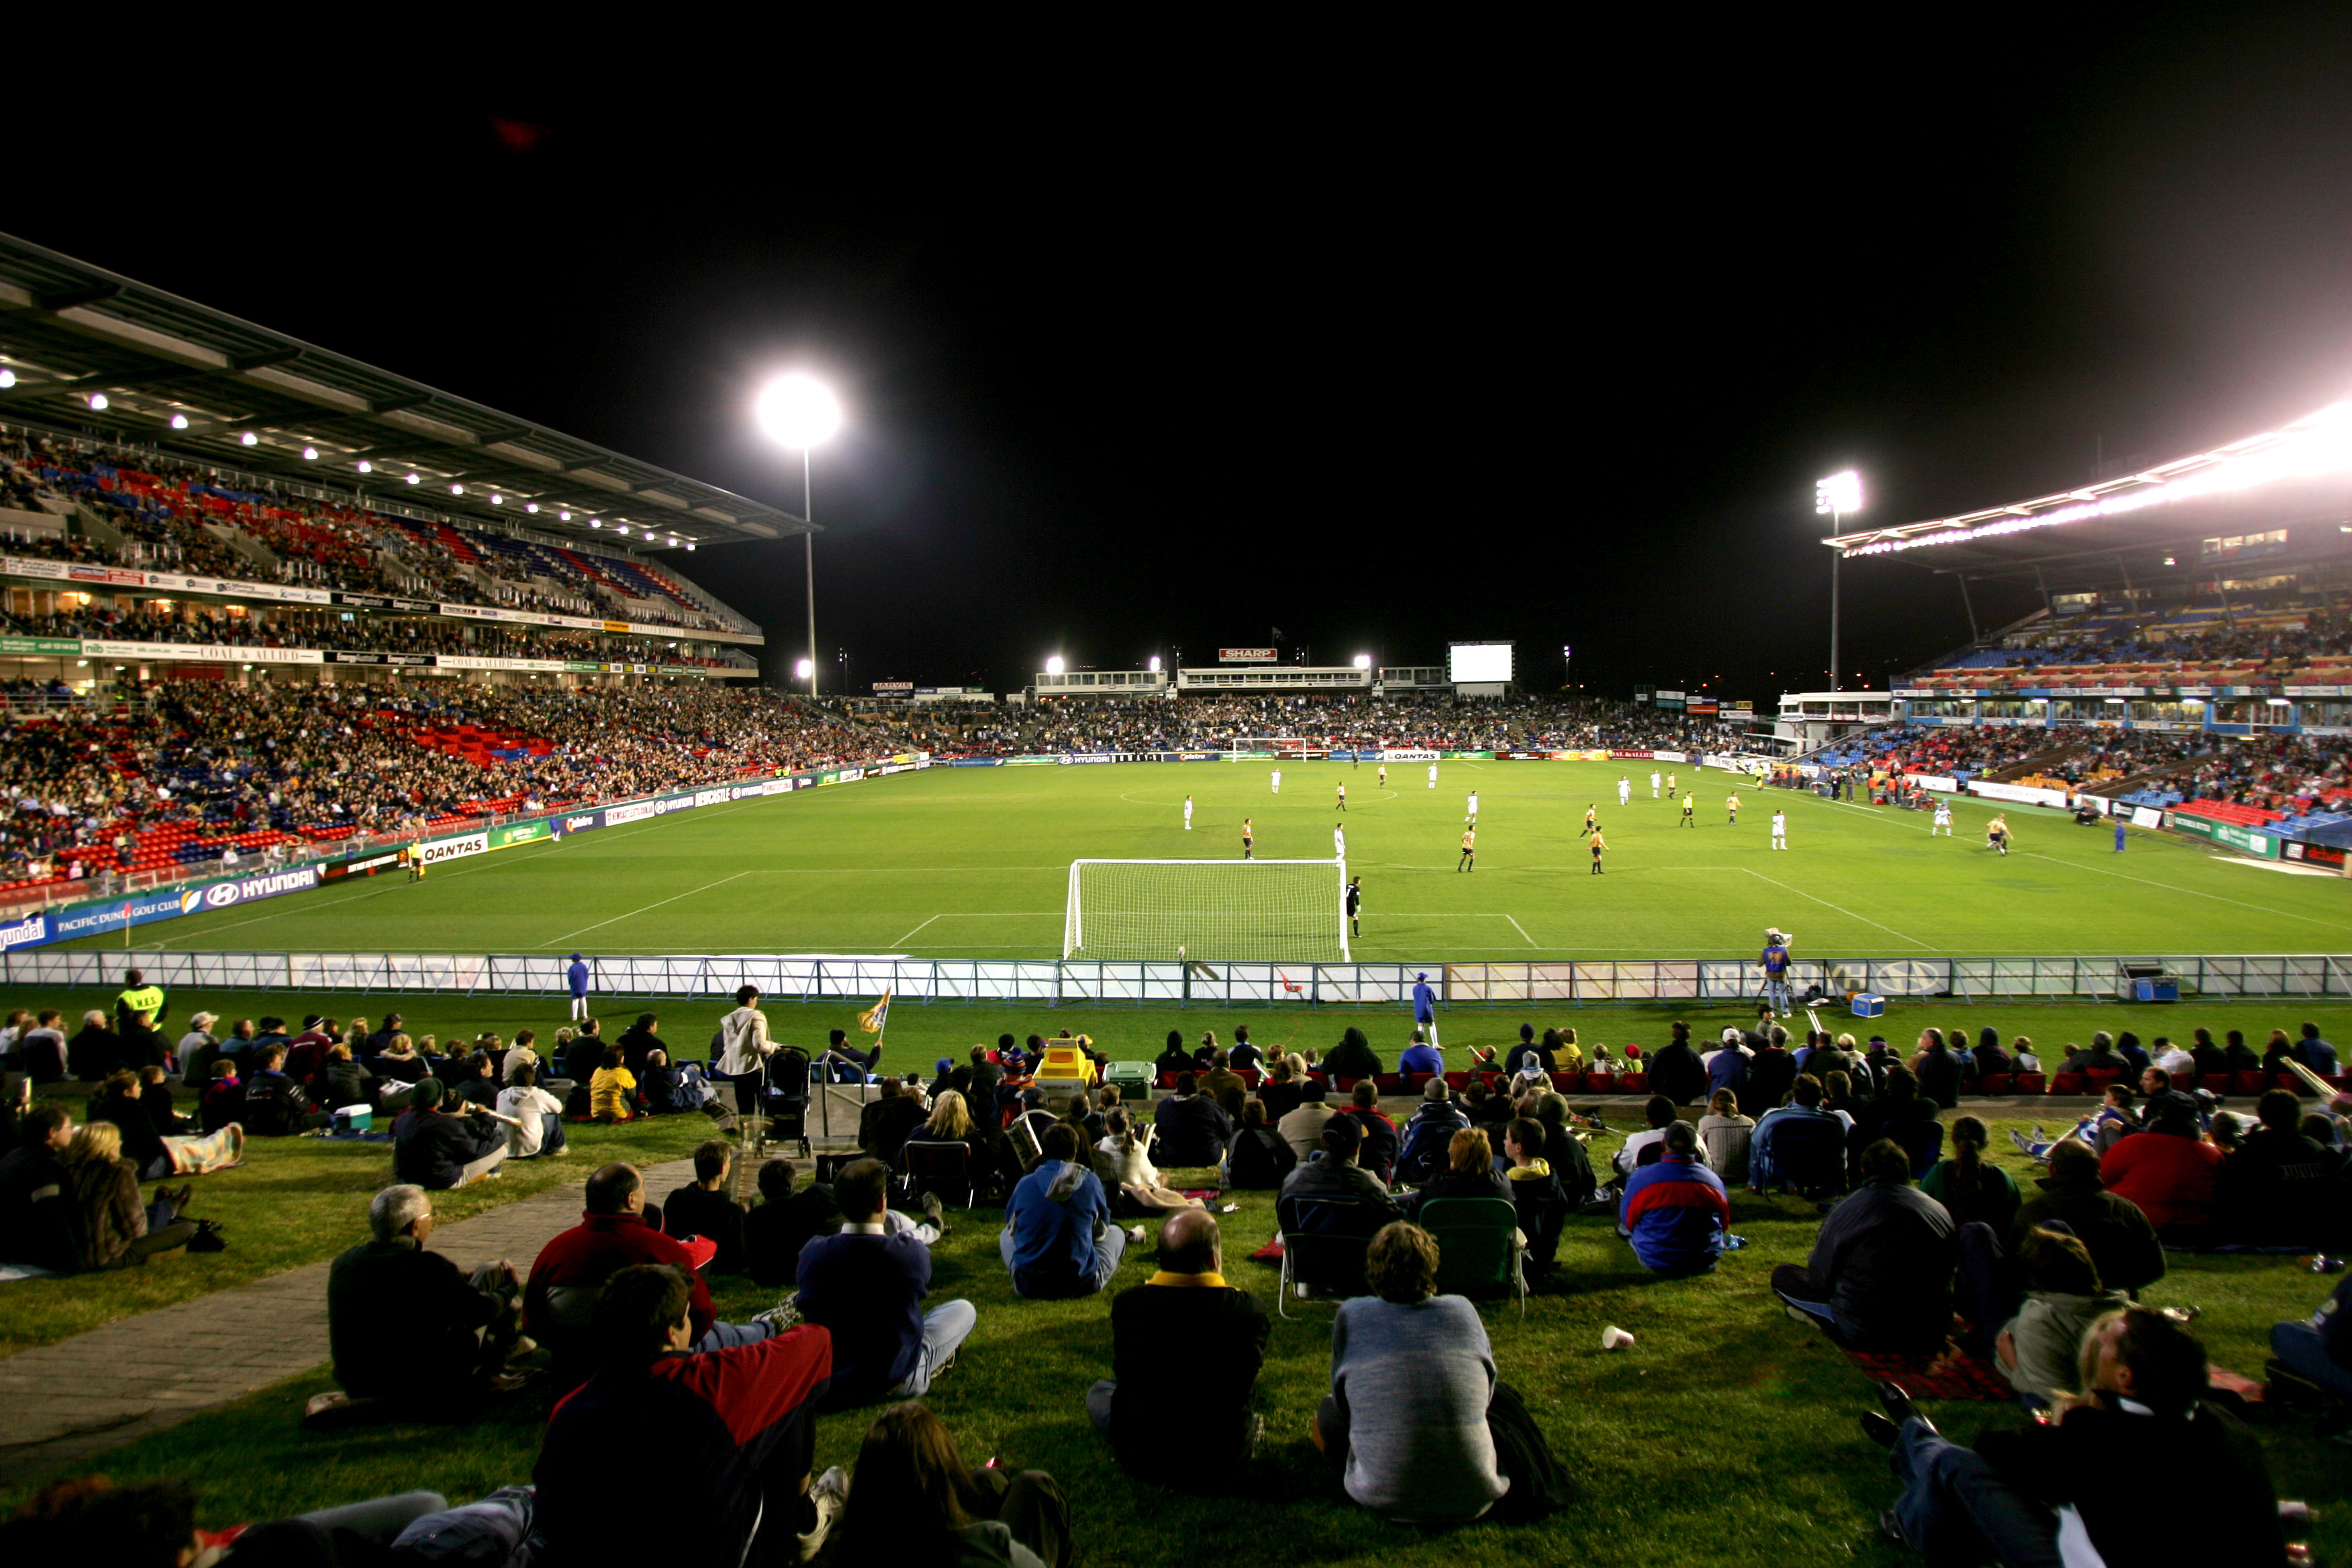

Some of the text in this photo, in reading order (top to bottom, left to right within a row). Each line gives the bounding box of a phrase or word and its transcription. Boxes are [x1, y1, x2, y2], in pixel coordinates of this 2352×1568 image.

[85, 643, 103, 654] nib
[200, 646, 236, 659] COAL
[256, 650, 299, 661] ALLIED
[452, 658, 472, 667] COAL
[485, 660, 512, 669] ALLIED
[695, 787, 730, 807] NEWCASTLE
[741, 785, 763, 797] HYUNDAI
[667, 796, 694, 811] HYUNDAI
[512, 827, 538, 836] AUSTRALIA
[566, 816, 593, 832] Telstra
[425, 840, 481, 861] QANTAS
[242, 869, 314, 898] HYUNDAI
[58, 915, 98, 932] PACIFIC
[132, 903, 156, 917] GOLF
[158, 899, 181, 912] CLUB
[0, 917, 45, 951] yundai
[136, 996, 158, 1008] N.E.S.
